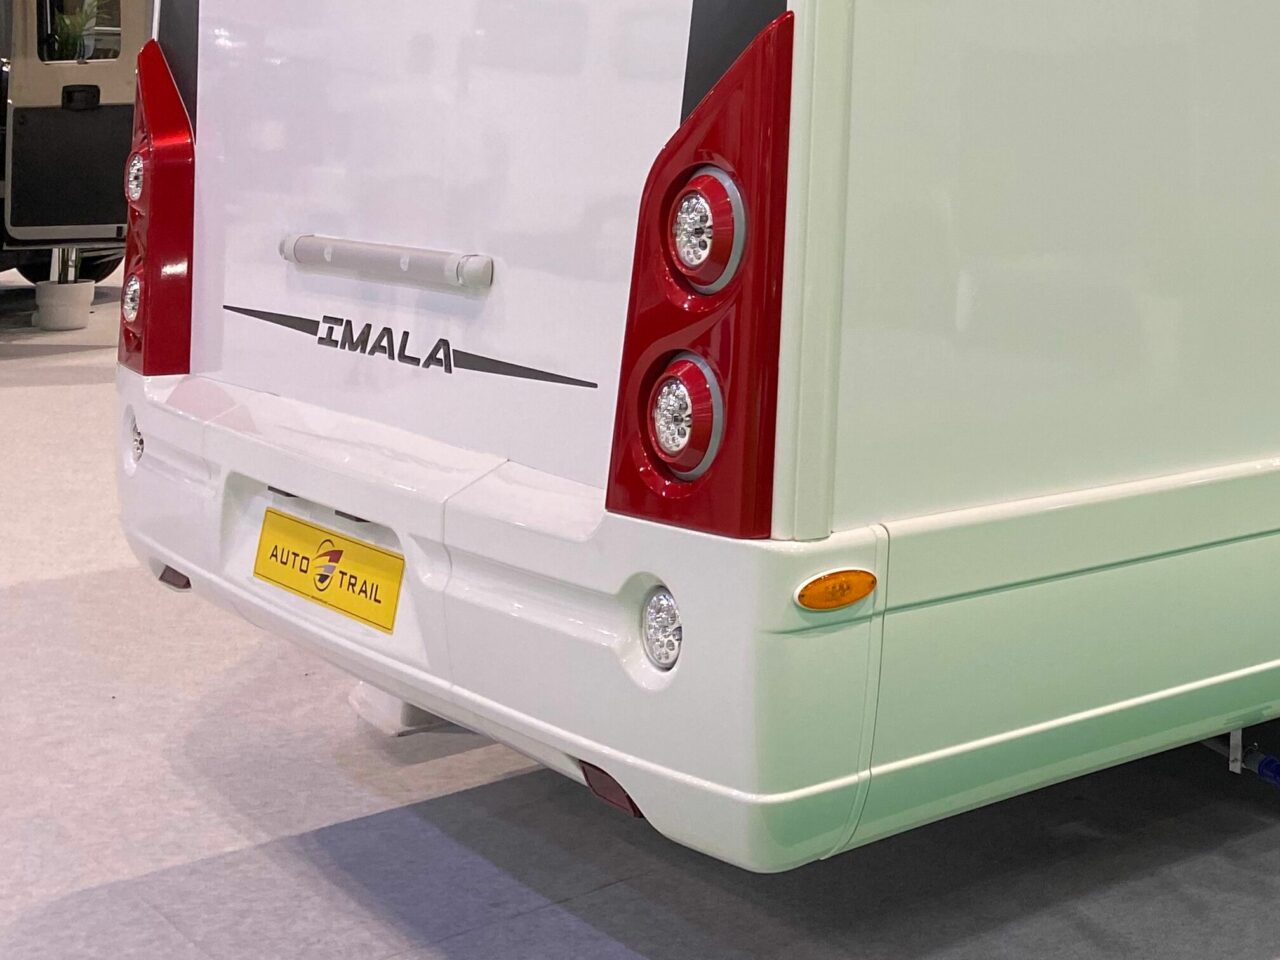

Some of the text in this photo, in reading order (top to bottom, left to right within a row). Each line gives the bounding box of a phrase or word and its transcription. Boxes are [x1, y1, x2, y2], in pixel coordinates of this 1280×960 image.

[317, 315, 453, 374] IMALA
[269, 544, 382, 604] AUTO TRAIL
